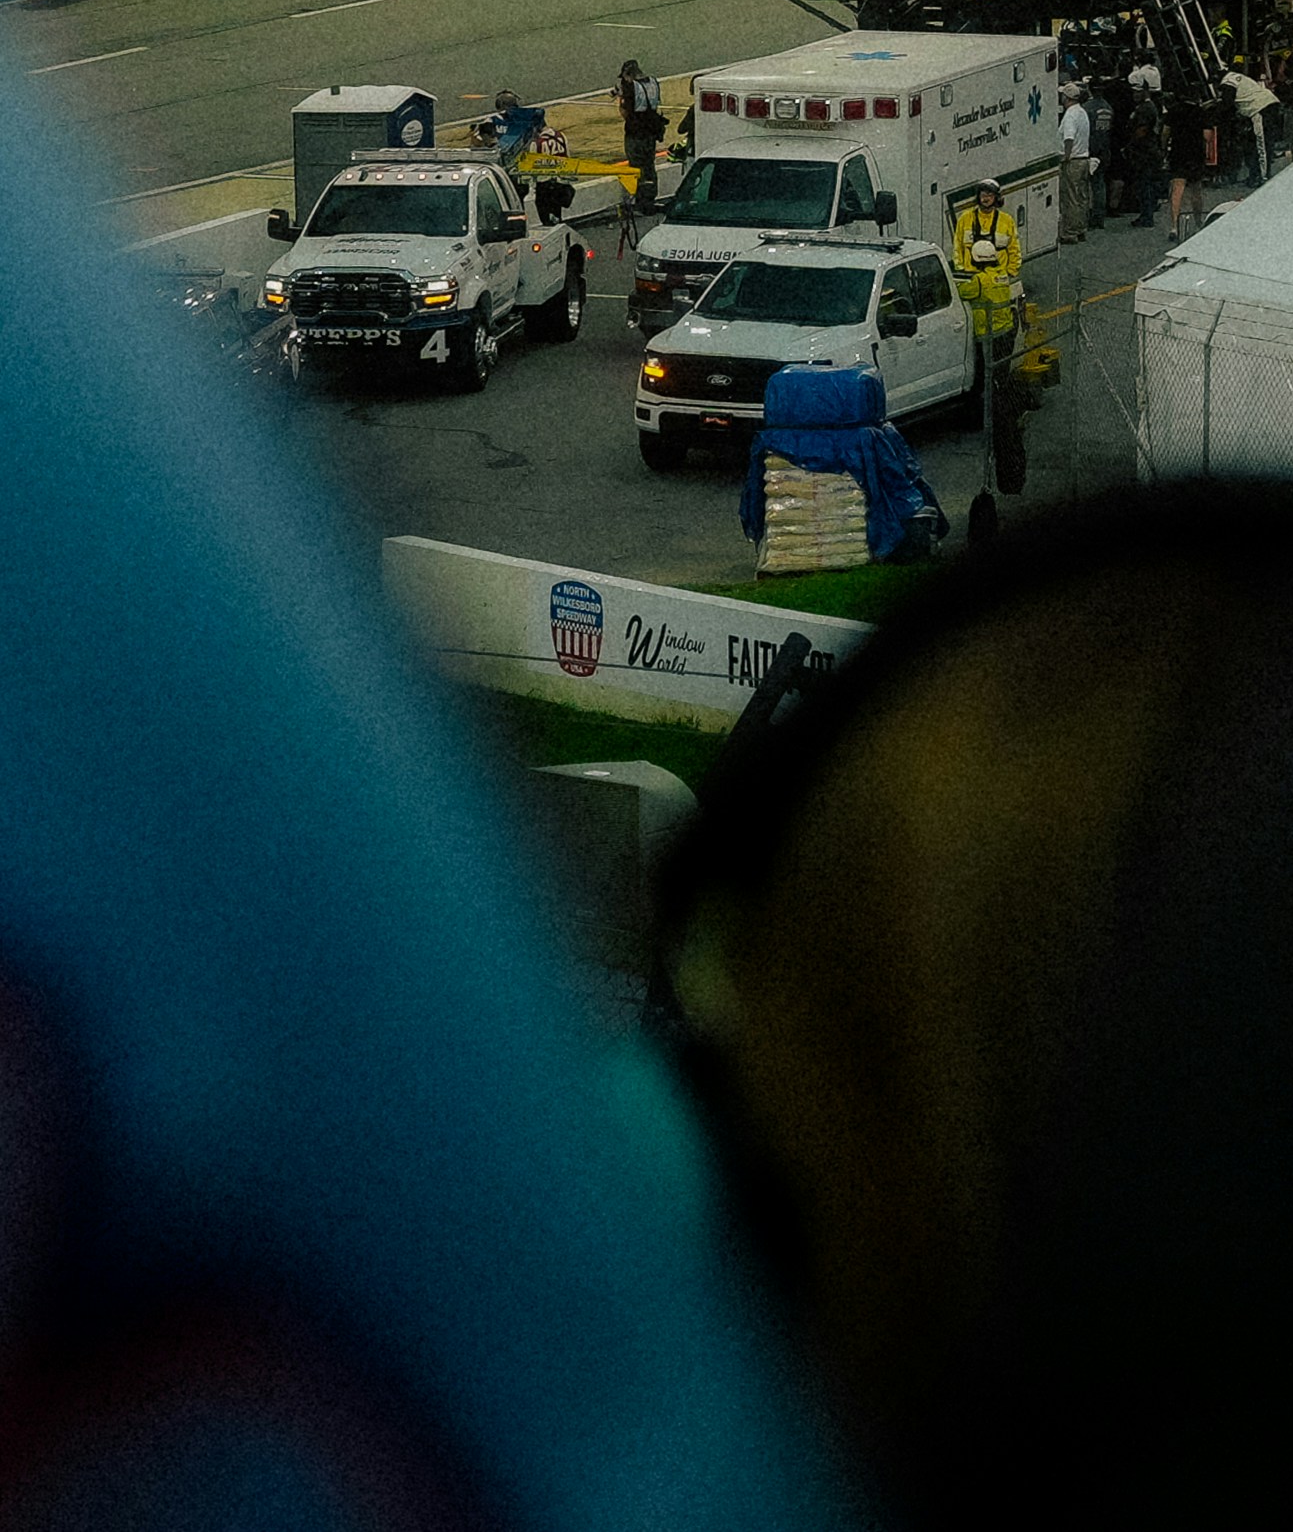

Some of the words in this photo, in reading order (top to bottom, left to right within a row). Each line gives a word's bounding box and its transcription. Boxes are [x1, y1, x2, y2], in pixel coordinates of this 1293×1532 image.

[999, 122, 1010, 139] NC
[419, 328, 450, 364] 4
[563, 584, 590, 598] NORTH
[556, 607, 597, 626] SPEEDWAY
